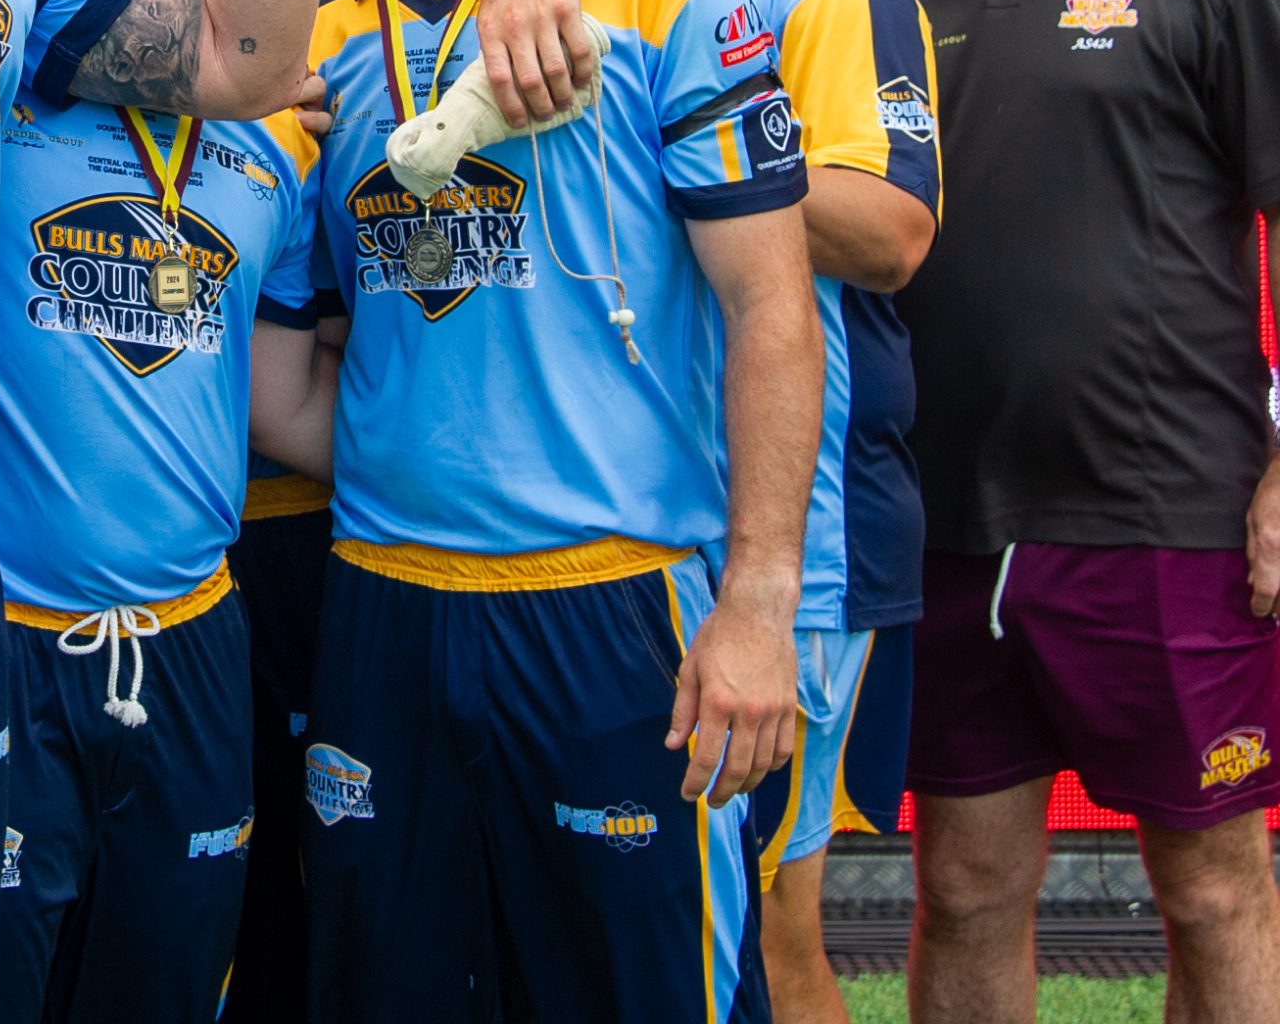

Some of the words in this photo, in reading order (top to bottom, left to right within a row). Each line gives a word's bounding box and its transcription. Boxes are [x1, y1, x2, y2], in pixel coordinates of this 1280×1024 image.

[1, 128, 43, 141] ORDER
[48, 135, 84, 147] GROUP
[376, 127, 389, 135] THE
[88, 156, 122, 167] CENTRAL
[88, 164, 102, 173] THE
[103, 166, 128, 176] GABBA
[355, 190, 418, 219] BULLS
[48, 224, 124, 258] BULLS
[166, 275, 180, 284] 2024
[1209, 736, 1260, 769] BULLS
[1200, 748, 1272, 791] MASTERS
